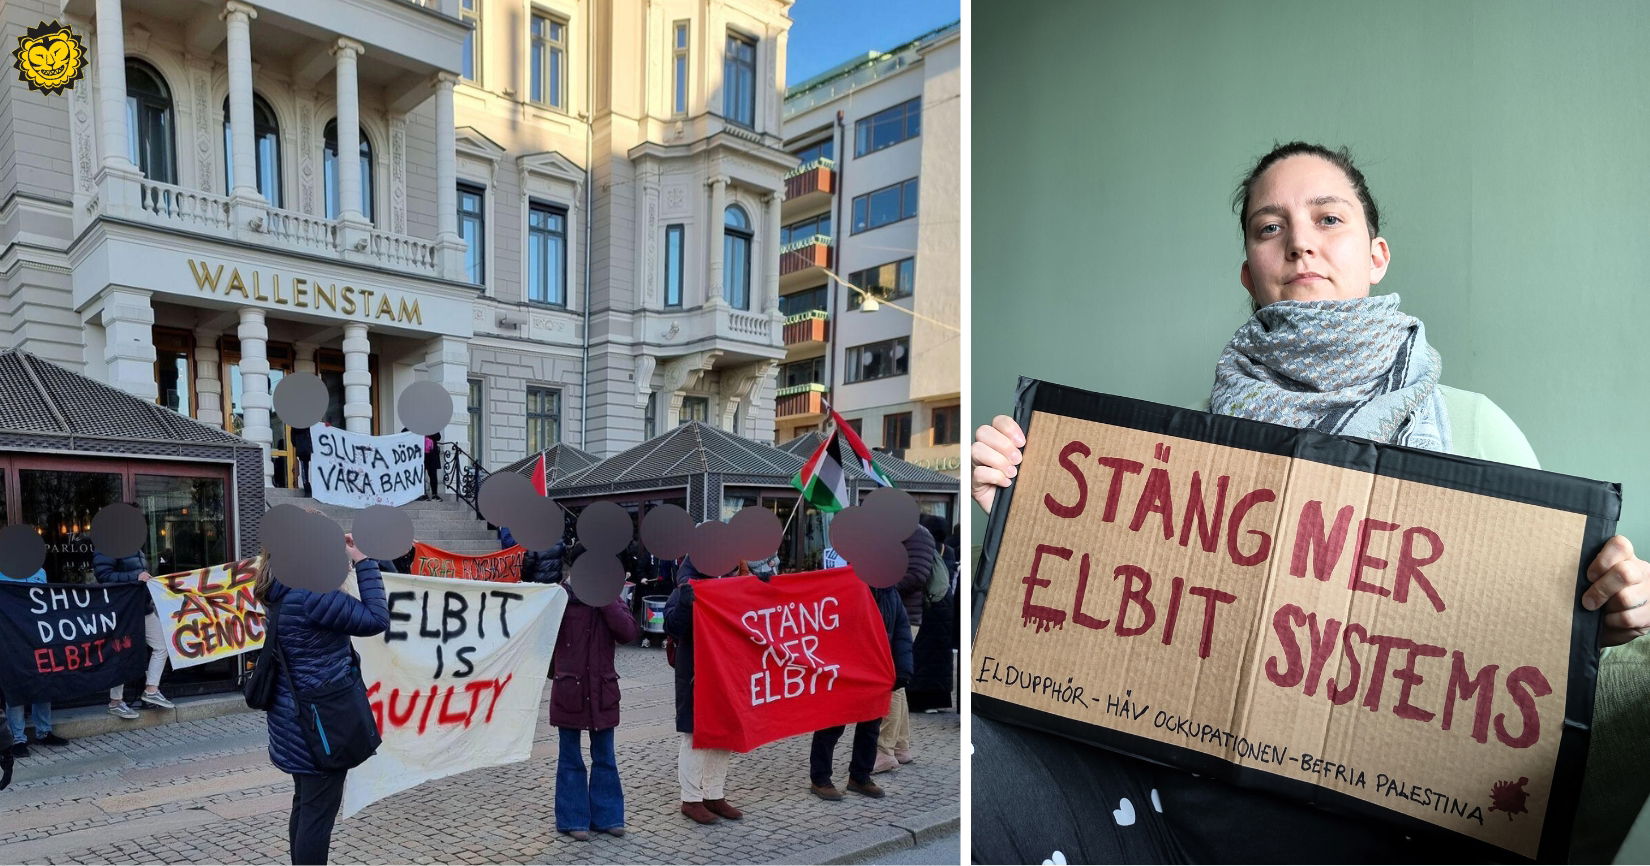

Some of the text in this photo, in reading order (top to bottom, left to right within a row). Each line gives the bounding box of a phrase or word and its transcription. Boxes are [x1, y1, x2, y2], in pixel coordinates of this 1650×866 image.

[187, 258, 423, 325] WALLENSTAM
[319, 434, 422, 469] SLUTA DÖDA
[317, 462, 424, 495] VÅRA BARN
[1043, 440, 1447, 613] STÄNG NER
[37, 611, 117, 643] DOWN
[172, 610, 268, 658] GENOC
[384, 590, 523, 644] ELBIT
[741, 596, 840, 645] STÄNG
[34, 639, 106, 673] ELBIT
[433, 644, 476, 679] IS
[762, 635, 824, 669] NER
[1021, 544, 1553, 749] ELBIT SYSTEMS
[750, 664, 840, 707] ELBIT
[976, 656, 1089, 709] ELDUPPHÖR
[1106, 689, 1150, 720] HÄV
[1376, 773, 1484, 826] PALESTINA
